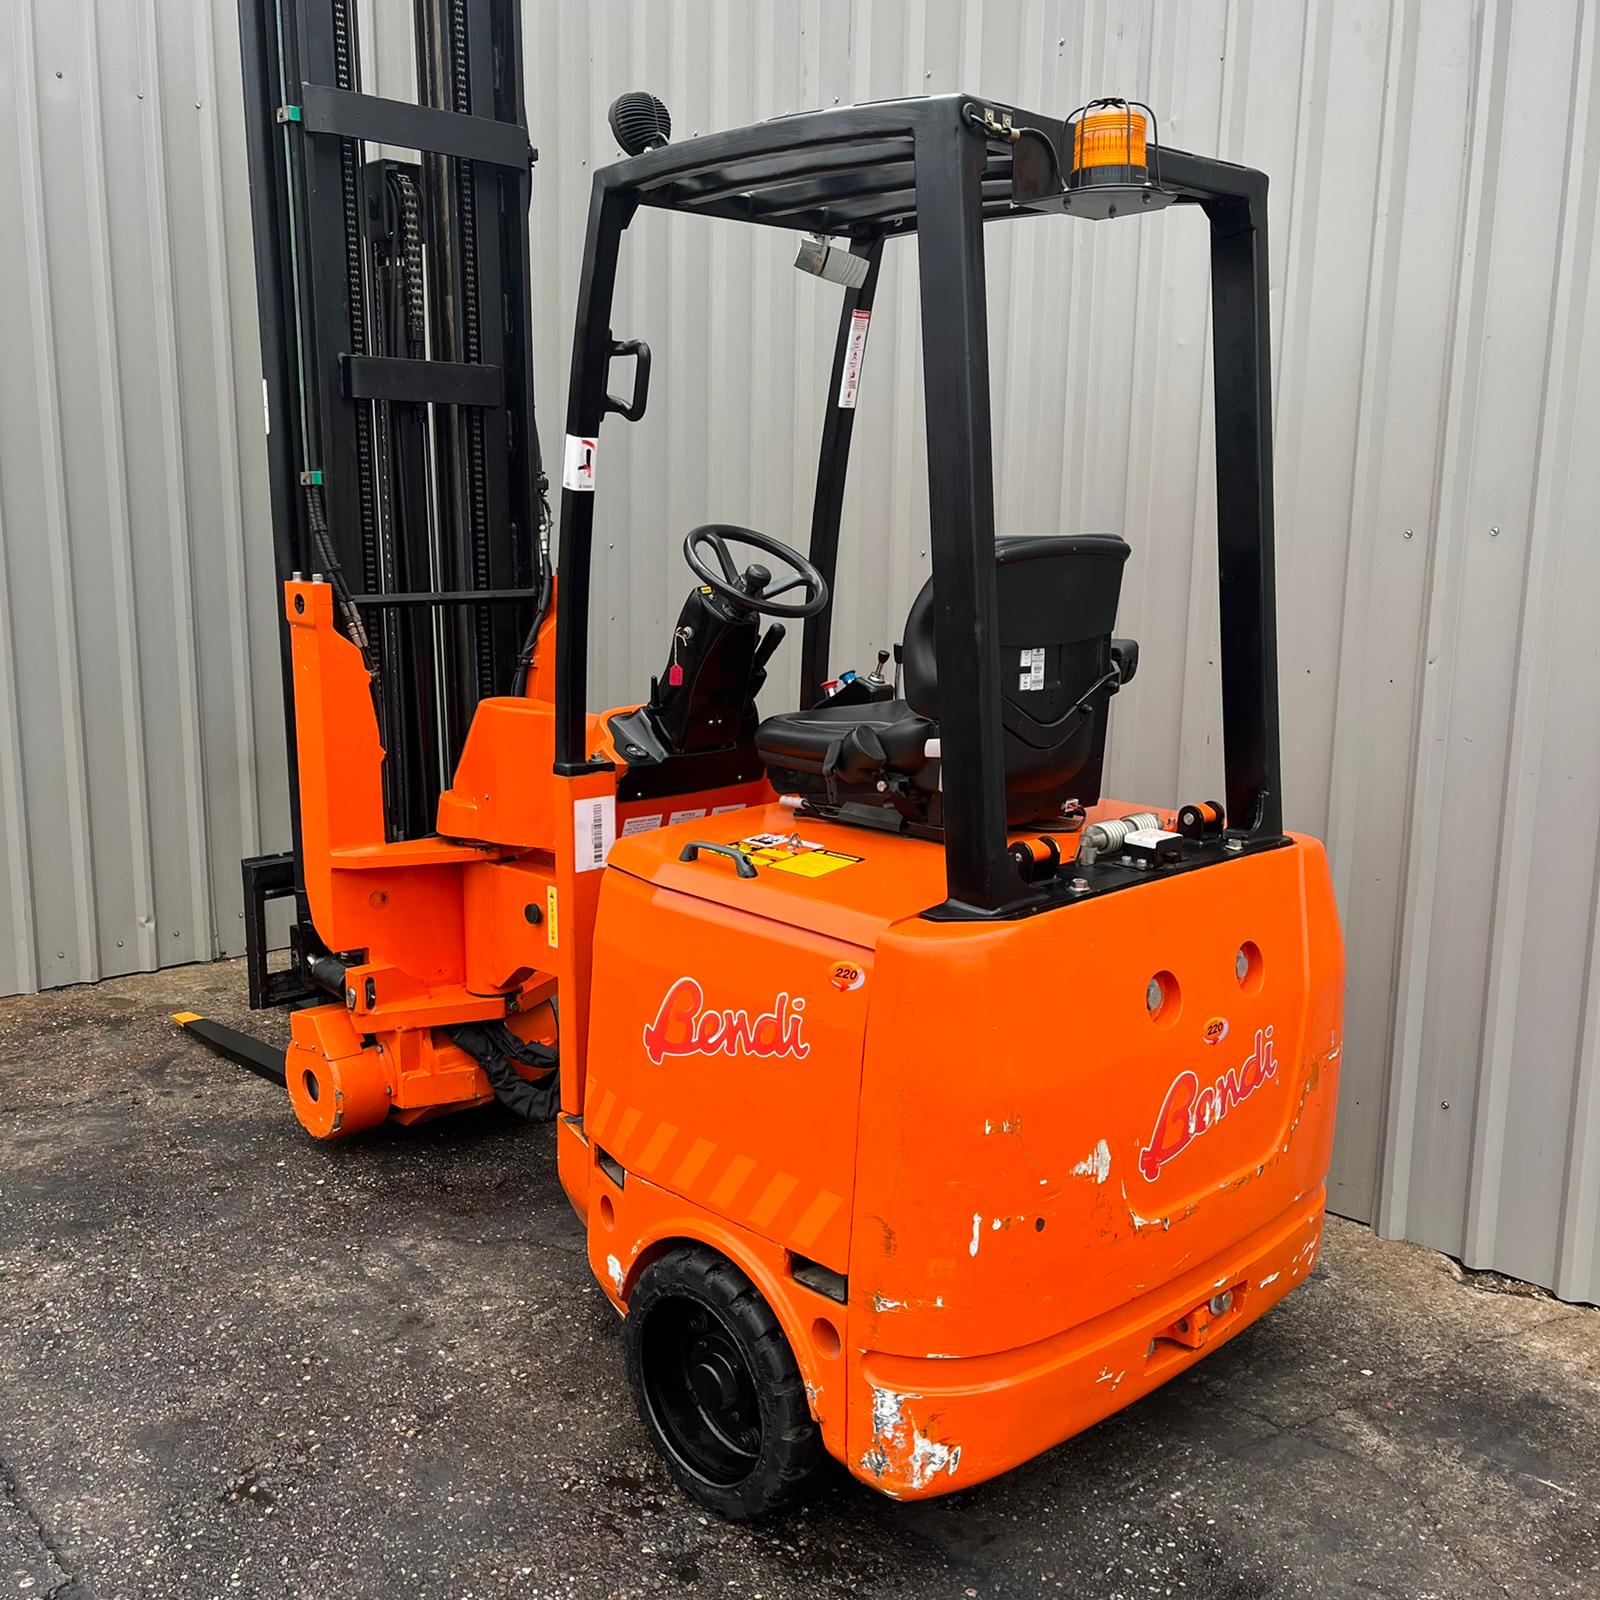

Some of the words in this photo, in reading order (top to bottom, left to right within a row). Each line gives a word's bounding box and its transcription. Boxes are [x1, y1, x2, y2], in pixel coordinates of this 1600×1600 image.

[834, 967, 858, 980] 220
[643, 976, 810, 1065] Bendi
[1207, 1022, 1223, 1036] 220
